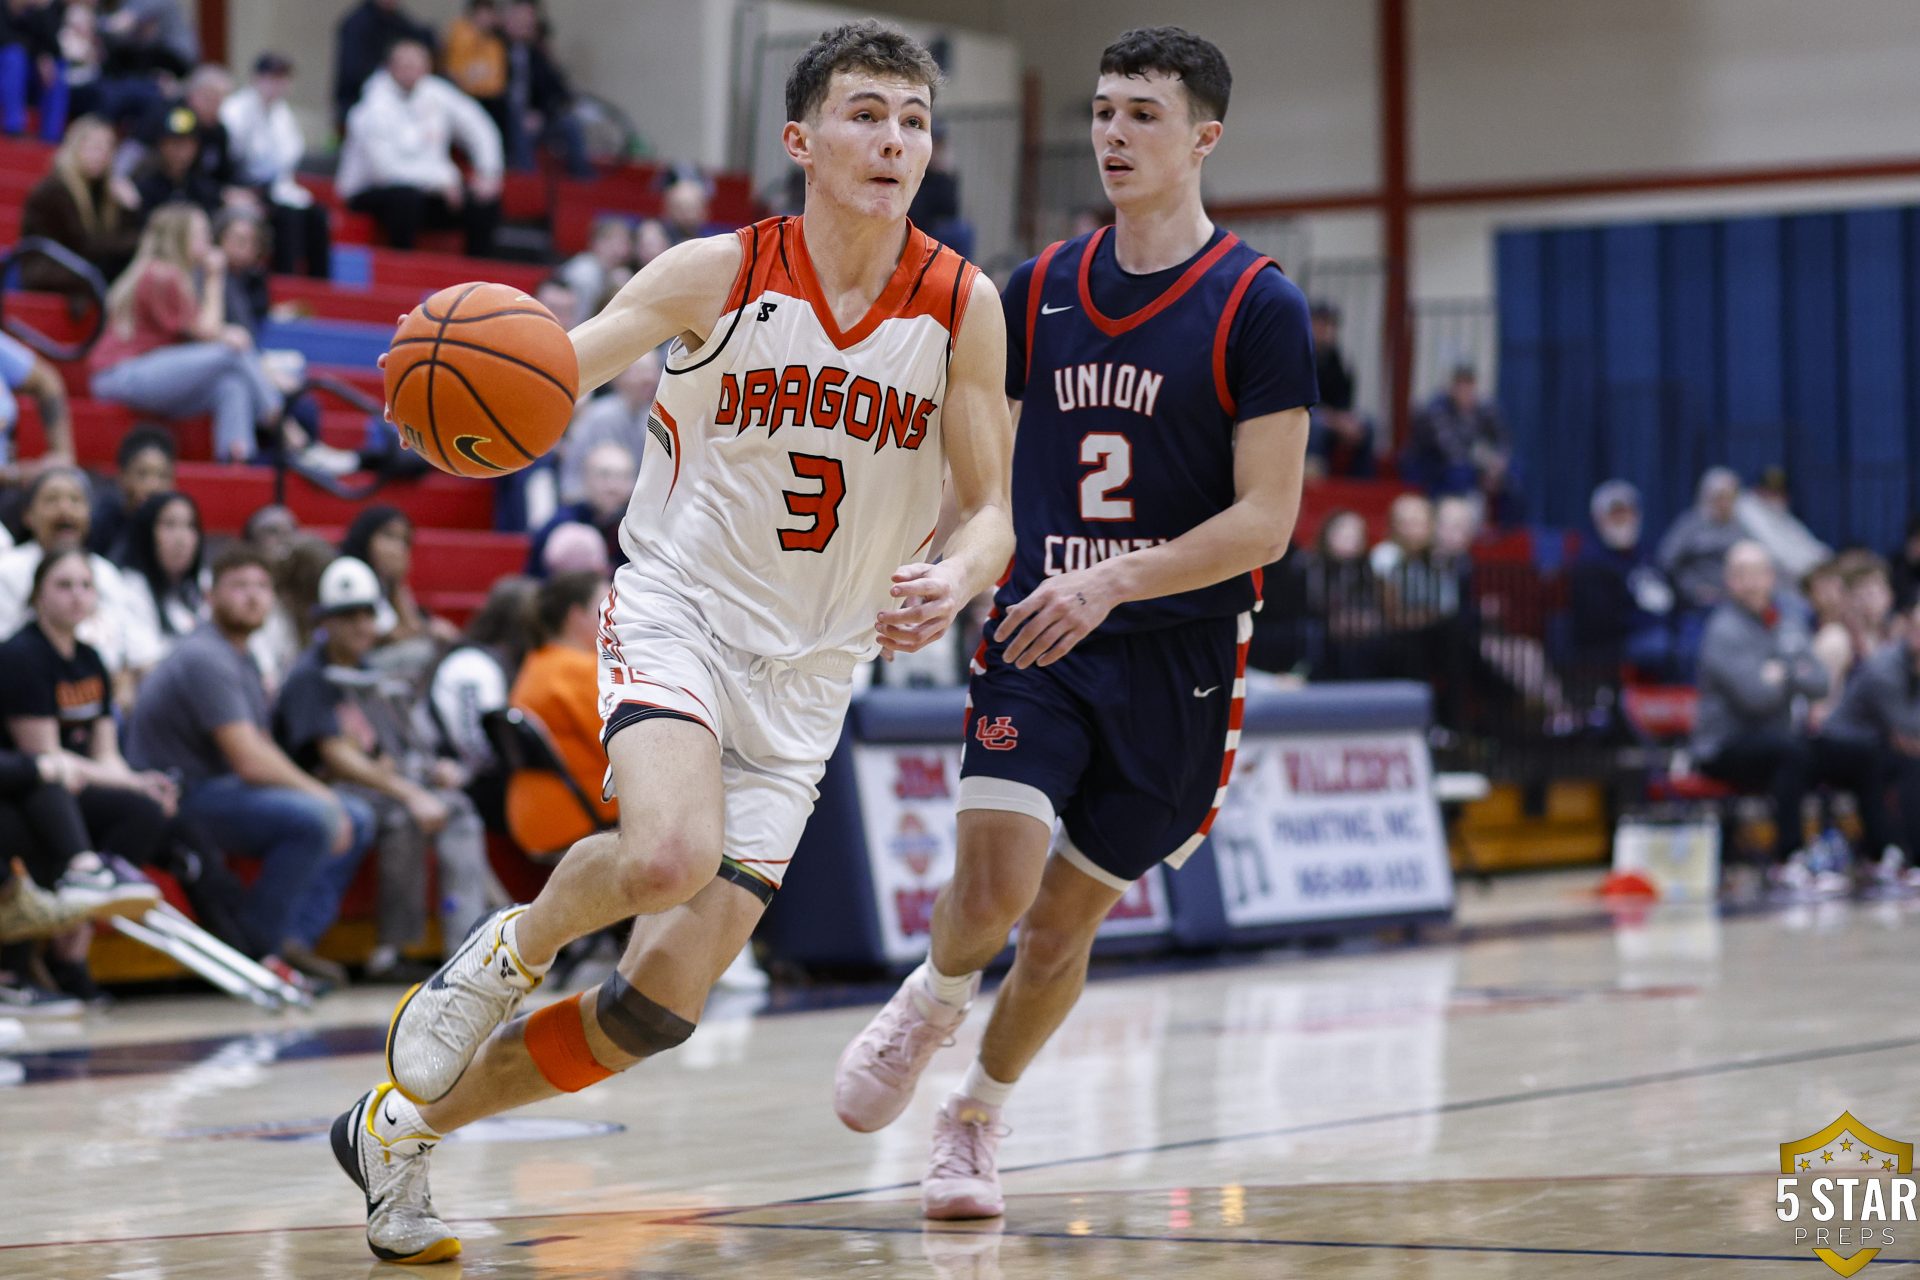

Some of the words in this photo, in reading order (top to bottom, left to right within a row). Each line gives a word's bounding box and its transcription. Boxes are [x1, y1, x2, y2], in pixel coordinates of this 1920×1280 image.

[714, 364, 938, 456] DRAGONS
[1054, 363, 1164, 417] UNION
[776, 450, 847, 554] 3
[1078, 431, 1136, 522] 2
